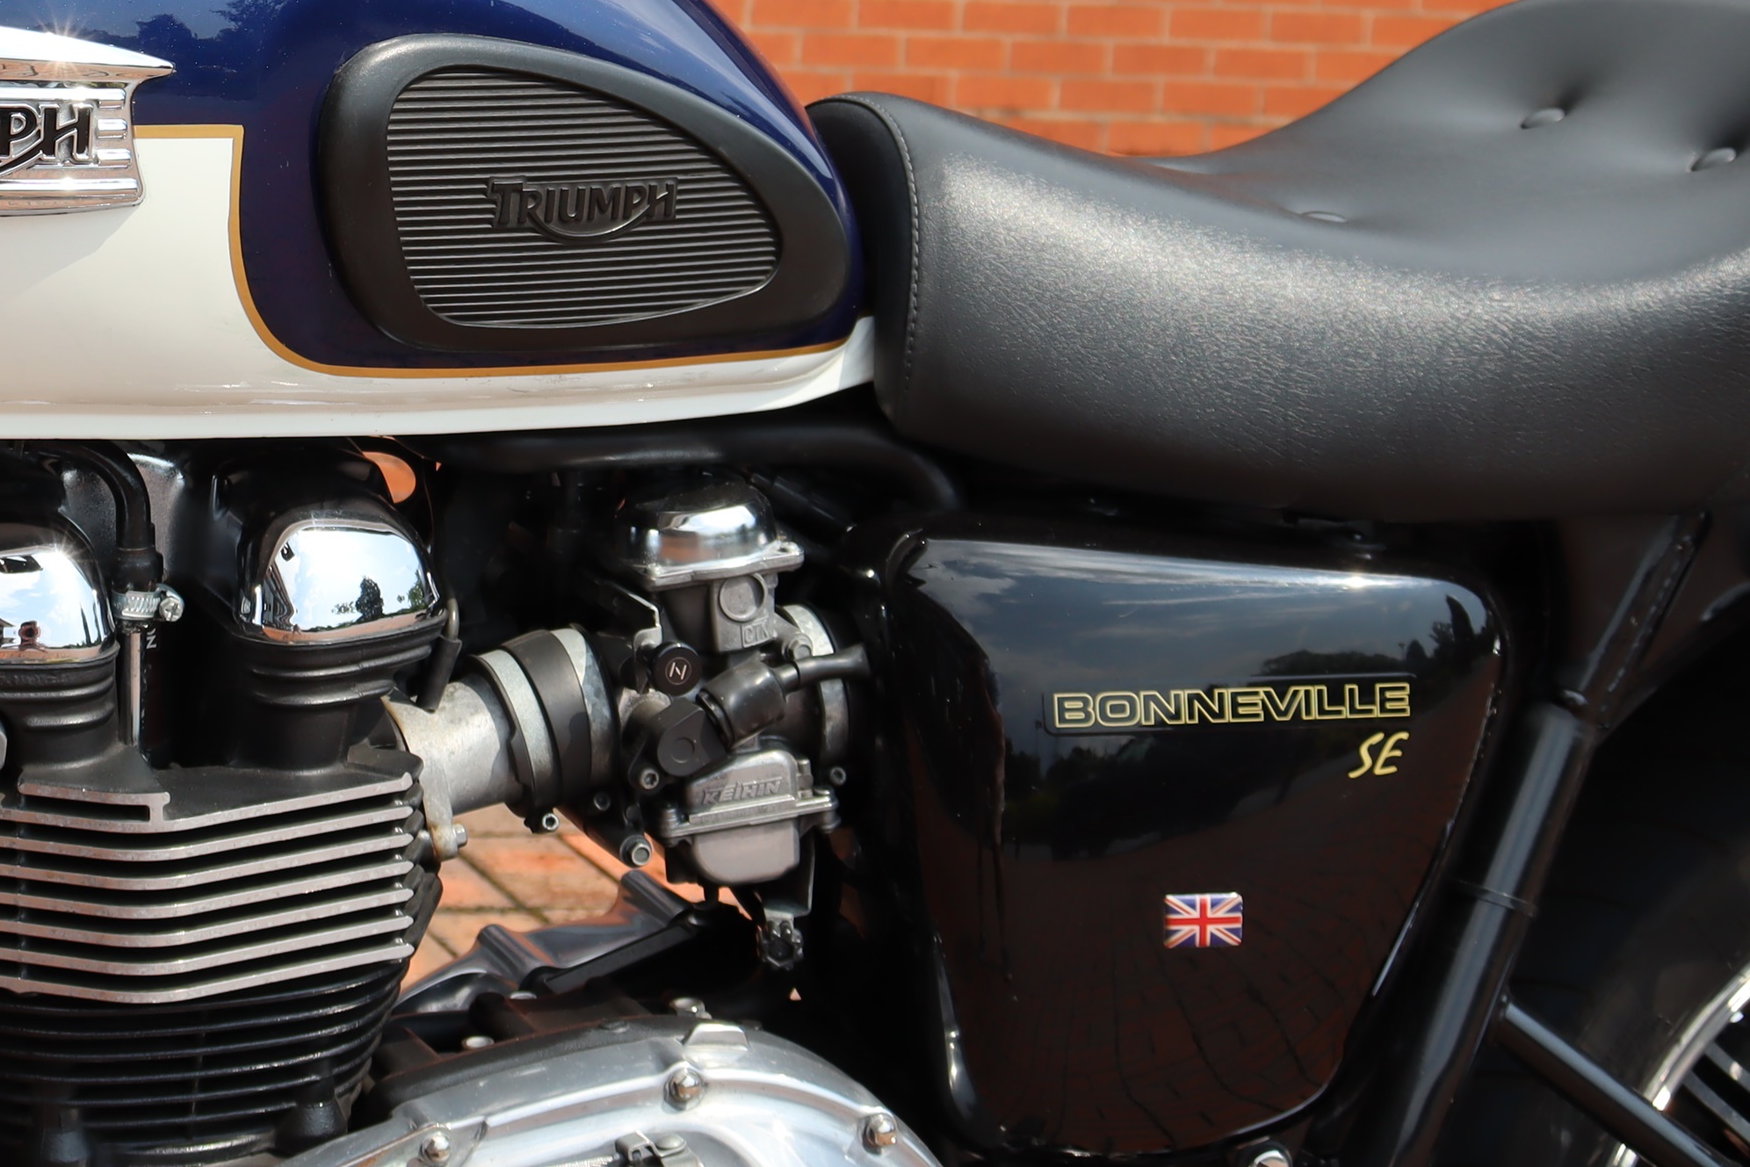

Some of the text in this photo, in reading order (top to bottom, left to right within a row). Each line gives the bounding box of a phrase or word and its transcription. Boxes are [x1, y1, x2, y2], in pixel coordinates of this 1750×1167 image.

[490, 178, 677, 244] TRIUMPH
[1053, 681, 1411, 729] BONNEVILLE
[1348, 732, 1409, 779] SE
[702, 779, 782, 806] KEIHIN
